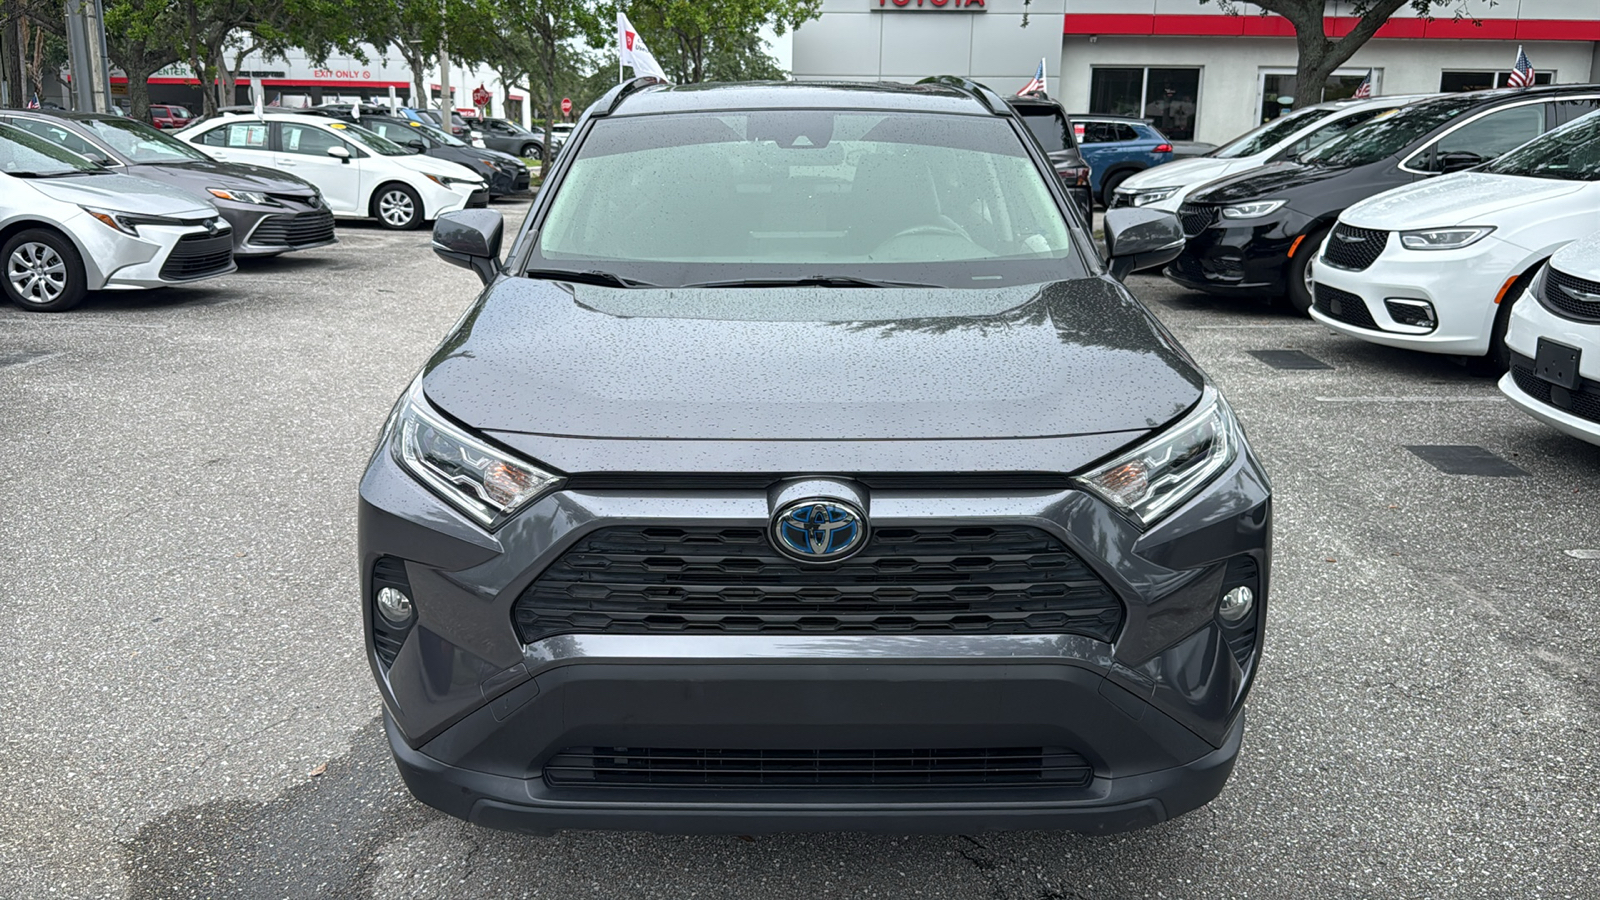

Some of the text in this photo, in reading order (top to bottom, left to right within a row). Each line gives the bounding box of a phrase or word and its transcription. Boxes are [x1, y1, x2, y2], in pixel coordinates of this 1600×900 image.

[157, 67, 187, 76] ENTER
[314, 69, 360, 78] EXIT ONLY
